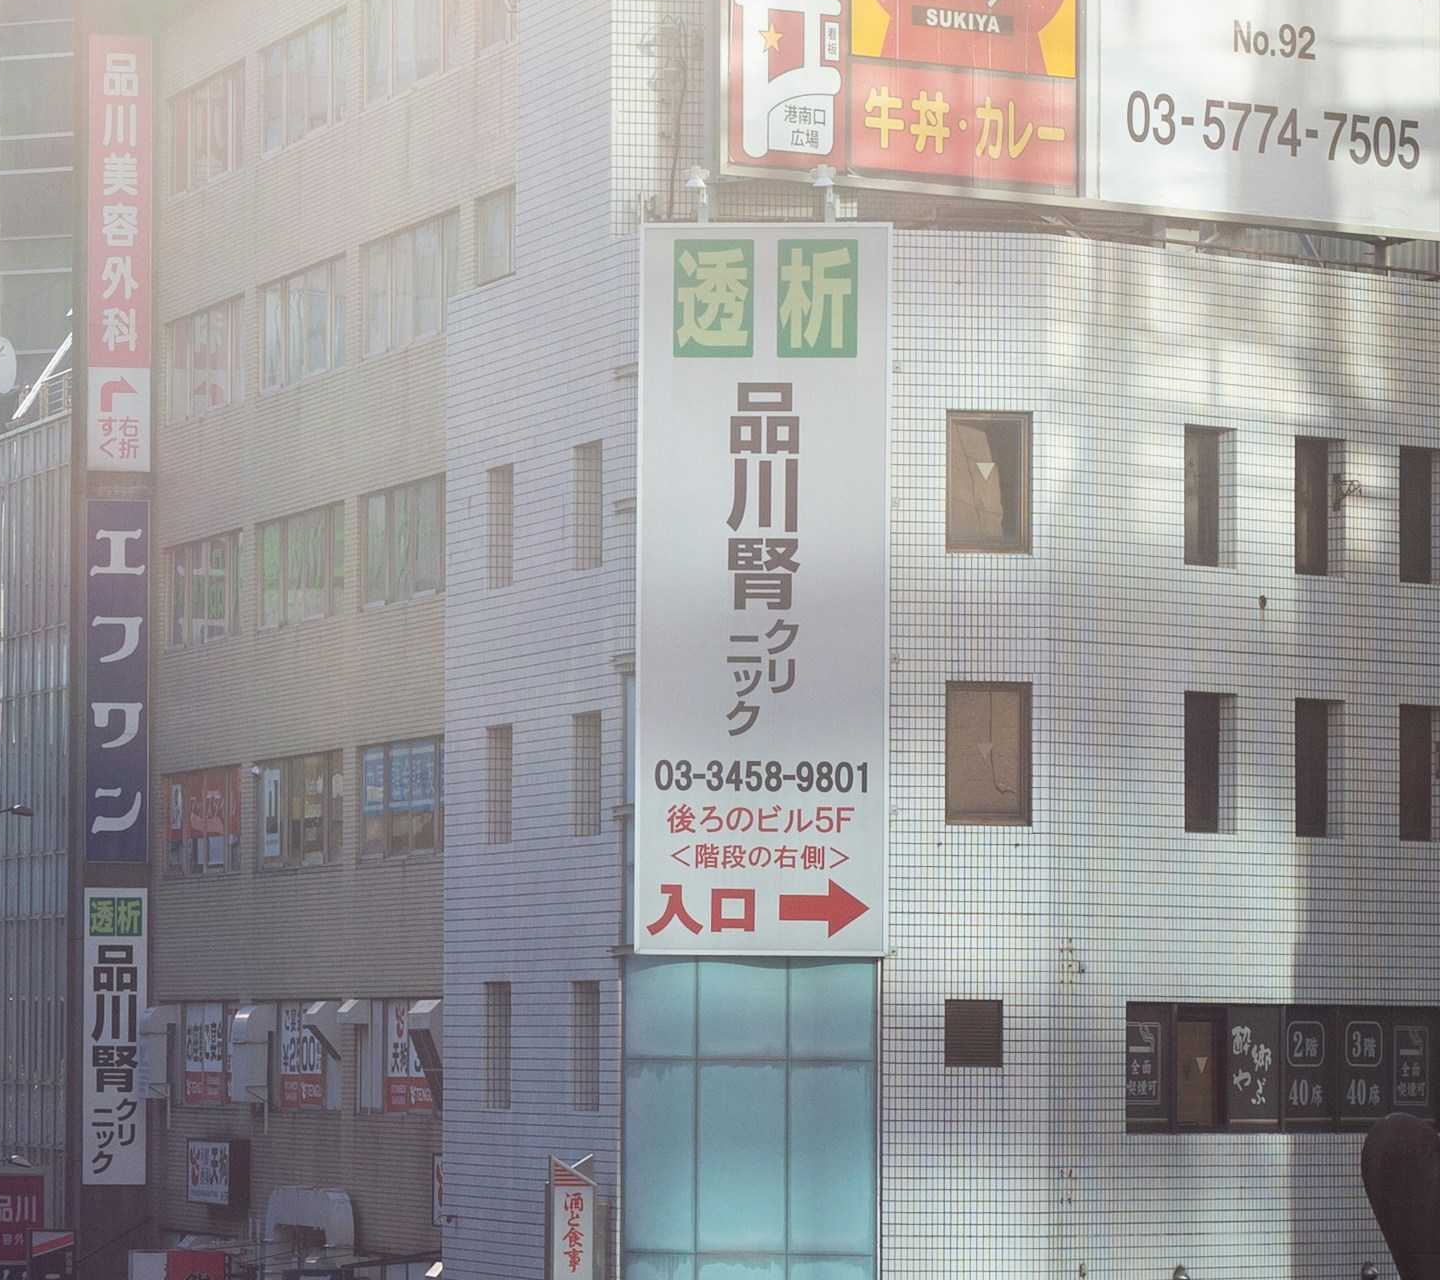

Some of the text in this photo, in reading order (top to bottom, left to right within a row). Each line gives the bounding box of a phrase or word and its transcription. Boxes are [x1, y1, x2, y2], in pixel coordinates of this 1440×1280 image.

[925, 7, 1002, 35] SUKIYA
[1232, 20, 1317, 62] No.92
[783, 104, 827, 129] 港南口
[790, 126, 820, 151] 広場
[863, 85, 1066, 160] 牛丼・カレー
[1125, 90, 1420, 171] 03-5774-7505
[101, 52, 140, 353] 品川美容外科
[676, 246, 856, 351] 透析
[90, 526, 147, 835] エフワン
[653, 758, 870, 796] 03-3458-9801
[665, 804, 855, 835] 後ろのビル5F
[89, 899, 141, 936] 透析
[645, 882, 757, 937] 入口
[561, 1190, 585, 1273] 酒と食事
